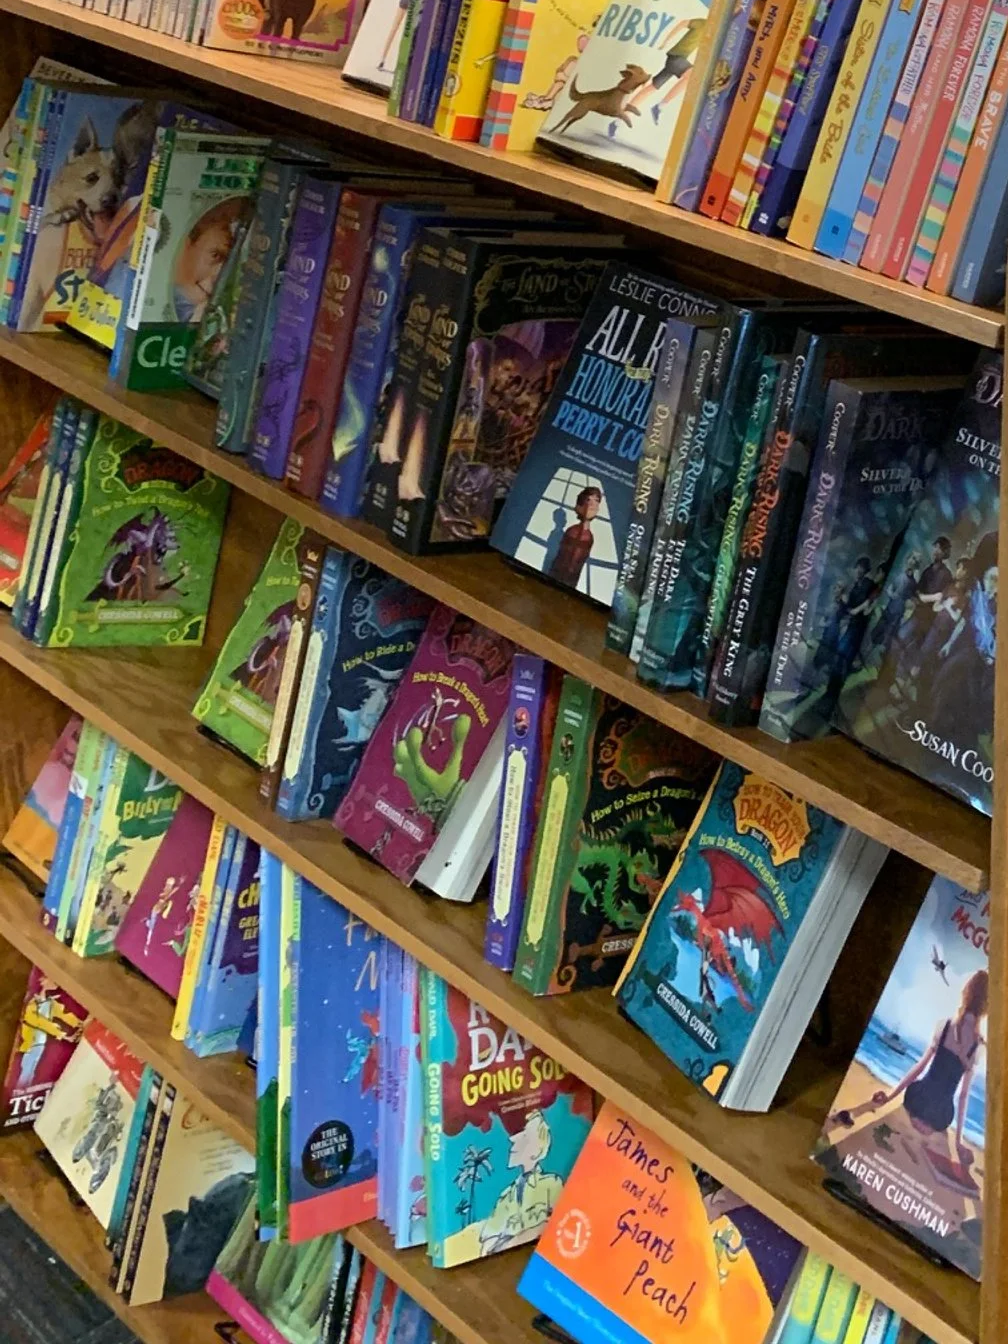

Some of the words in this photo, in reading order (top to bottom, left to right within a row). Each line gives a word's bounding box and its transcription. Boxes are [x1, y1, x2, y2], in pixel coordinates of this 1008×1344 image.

[597, 2, 675, 48] RIBSY
[850, 18, 875, 67] Sister
[960, 4, 985, 50] RAMONA
[943, 54, 968, 102] FOREVER
[834, 91, 853, 115] the
[973, 89, 1003, 150] BRAVE
[819, 120, 844, 164] Bride
[609, 274, 656, 304] LESLIE
[586, 304, 646, 365] ALL
[784, 355, 805, 413] COOPER
[552, 403, 611, 447] PERRY
[648, 403, 671, 450] DARK
[692, 400, 721, 455] DARK
[955, 426, 1001, 461] SILVE
[736, 442, 757, 491] DARK
[768, 430, 794, 486] DARK
[635, 454, 662, 514] RISING
[676, 457, 706, 524] RISING
[721, 494, 744, 554] RISING
[749, 487, 783, 558] RISING
[797, 525, 824, 590] RISING
[663, 564, 684, 602] DARK
[743, 567, 758, 597] THE
[732, 599, 751, 639] GREY
[790, 601, 809, 647] SILVER
[342, 655, 364, 673] How
[721, 640, 739, 679] KING
[908, 718, 960, 767] SUSAN
[590, 803, 613, 822] How
[613, 798, 624, 810] to
[625, 789, 652, 806] Seize
[739, 797, 798, 855] DRAGON
[699, 833, 715, 848] How
[725, 837, 751, 859] Betray
[755, 855, 782, 895] Dragon's
[776, 890, 791, 920] Hero
[655, 981, 692, 1023] CRESSIDA
[688, 1011, 719, 1051] COWELL
[427, 1062, 442, 1117] GOING
[461, 1064, 524, 1108] GOING
[310, 1135, 349, 1151] ORIGINAL
[320, 1127, 338, 1139] THE
[429, 1121, 443, 1162] SOLO
[606, 1118, 675, 1184] James
[621, 1178, 648, 1201] and
[648, 1188, 669, 1218] the
[842, 1152, 885, 1193] KAREN
[886, 1183, 950, 1239] CUSHMAN
[610, 1208, 676, 1265] Giant
[622, 1259, 697, 1325] Peach
